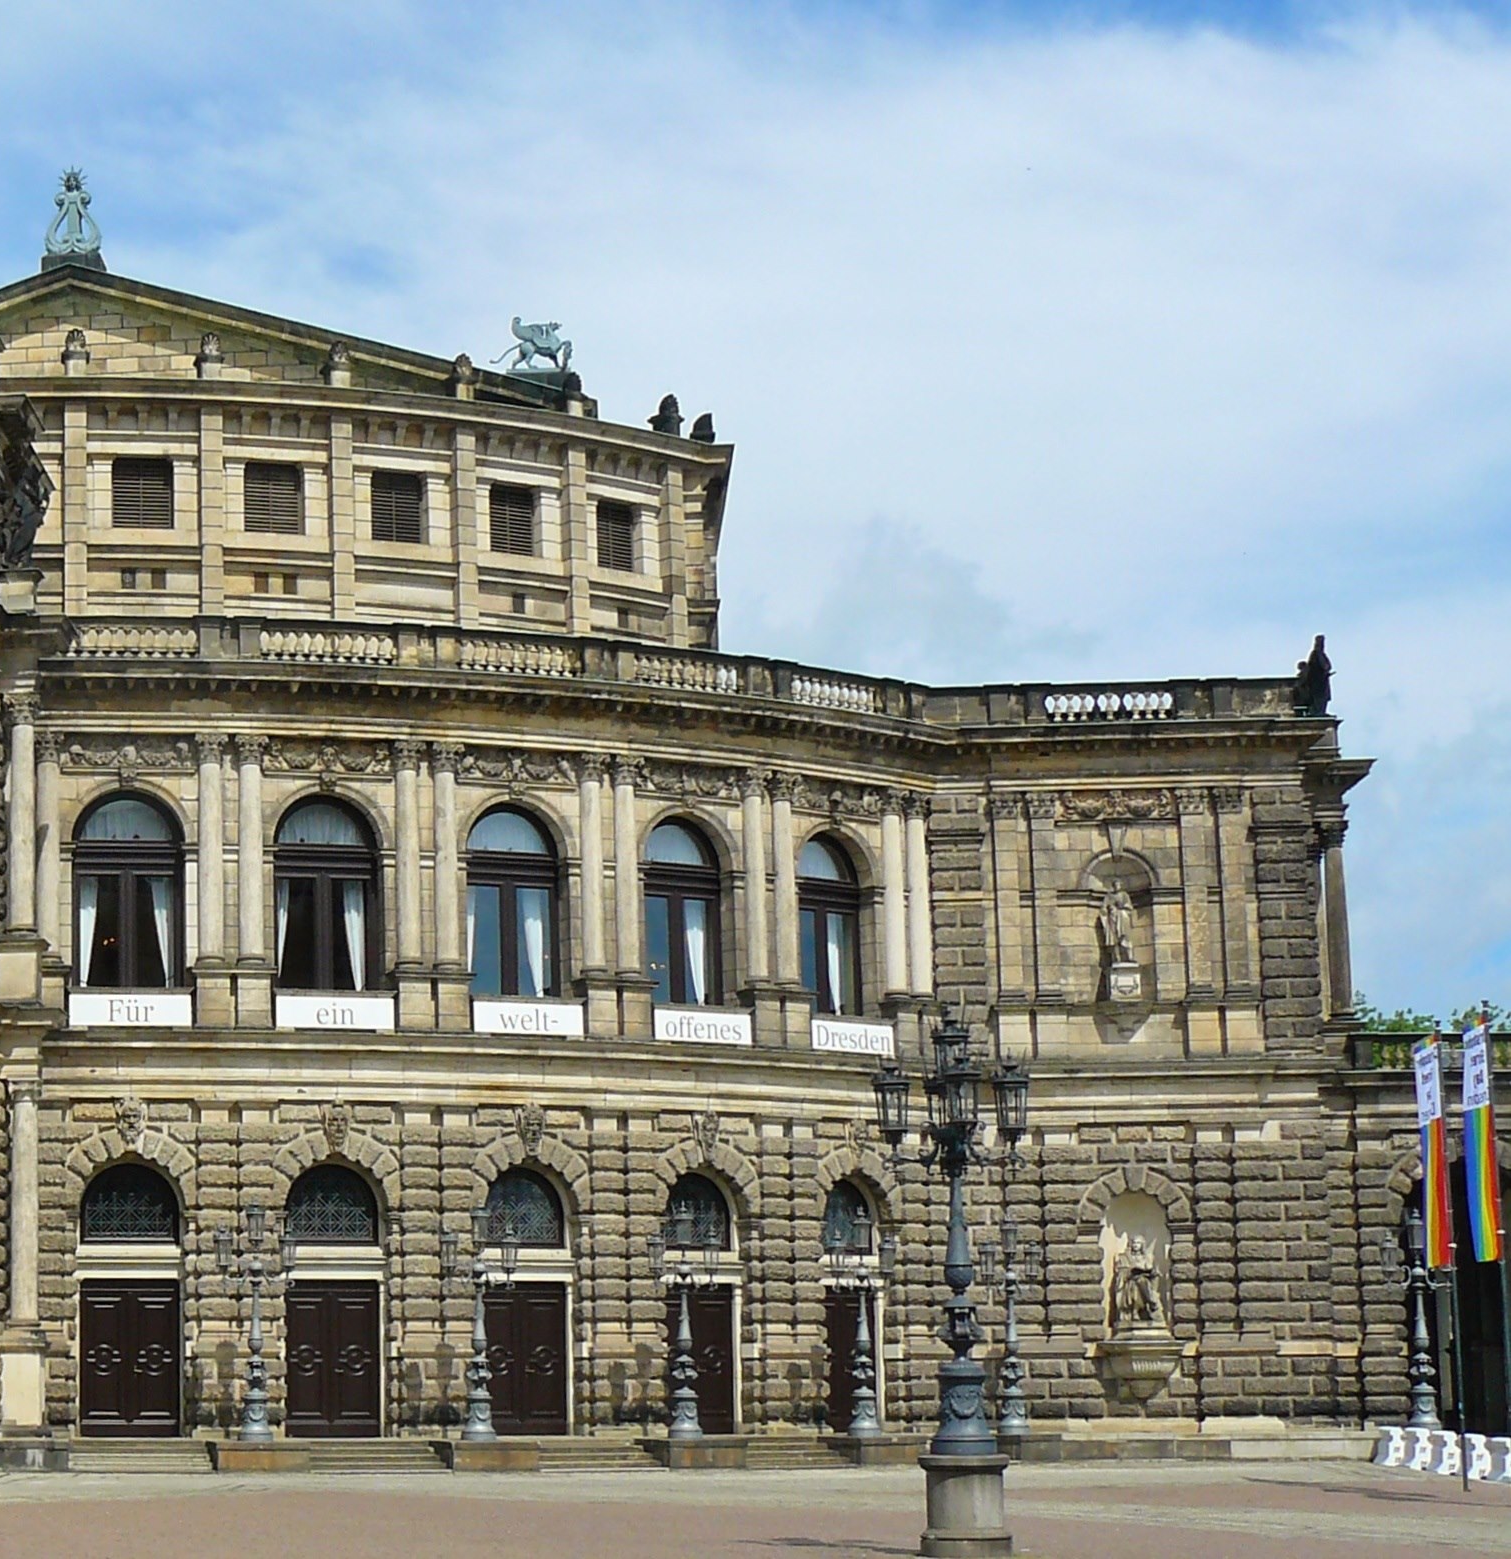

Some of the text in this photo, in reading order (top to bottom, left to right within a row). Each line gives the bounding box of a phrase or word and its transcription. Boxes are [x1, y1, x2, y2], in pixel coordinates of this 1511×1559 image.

[108, 999, 154, 1022] Für
[316, 1002, 355, 1025] ein
[500, 1008, 559, 1031] welt-
[665, 1015, 742, 1041] offenes
[816, 1024, 891, 1052] Dresden
